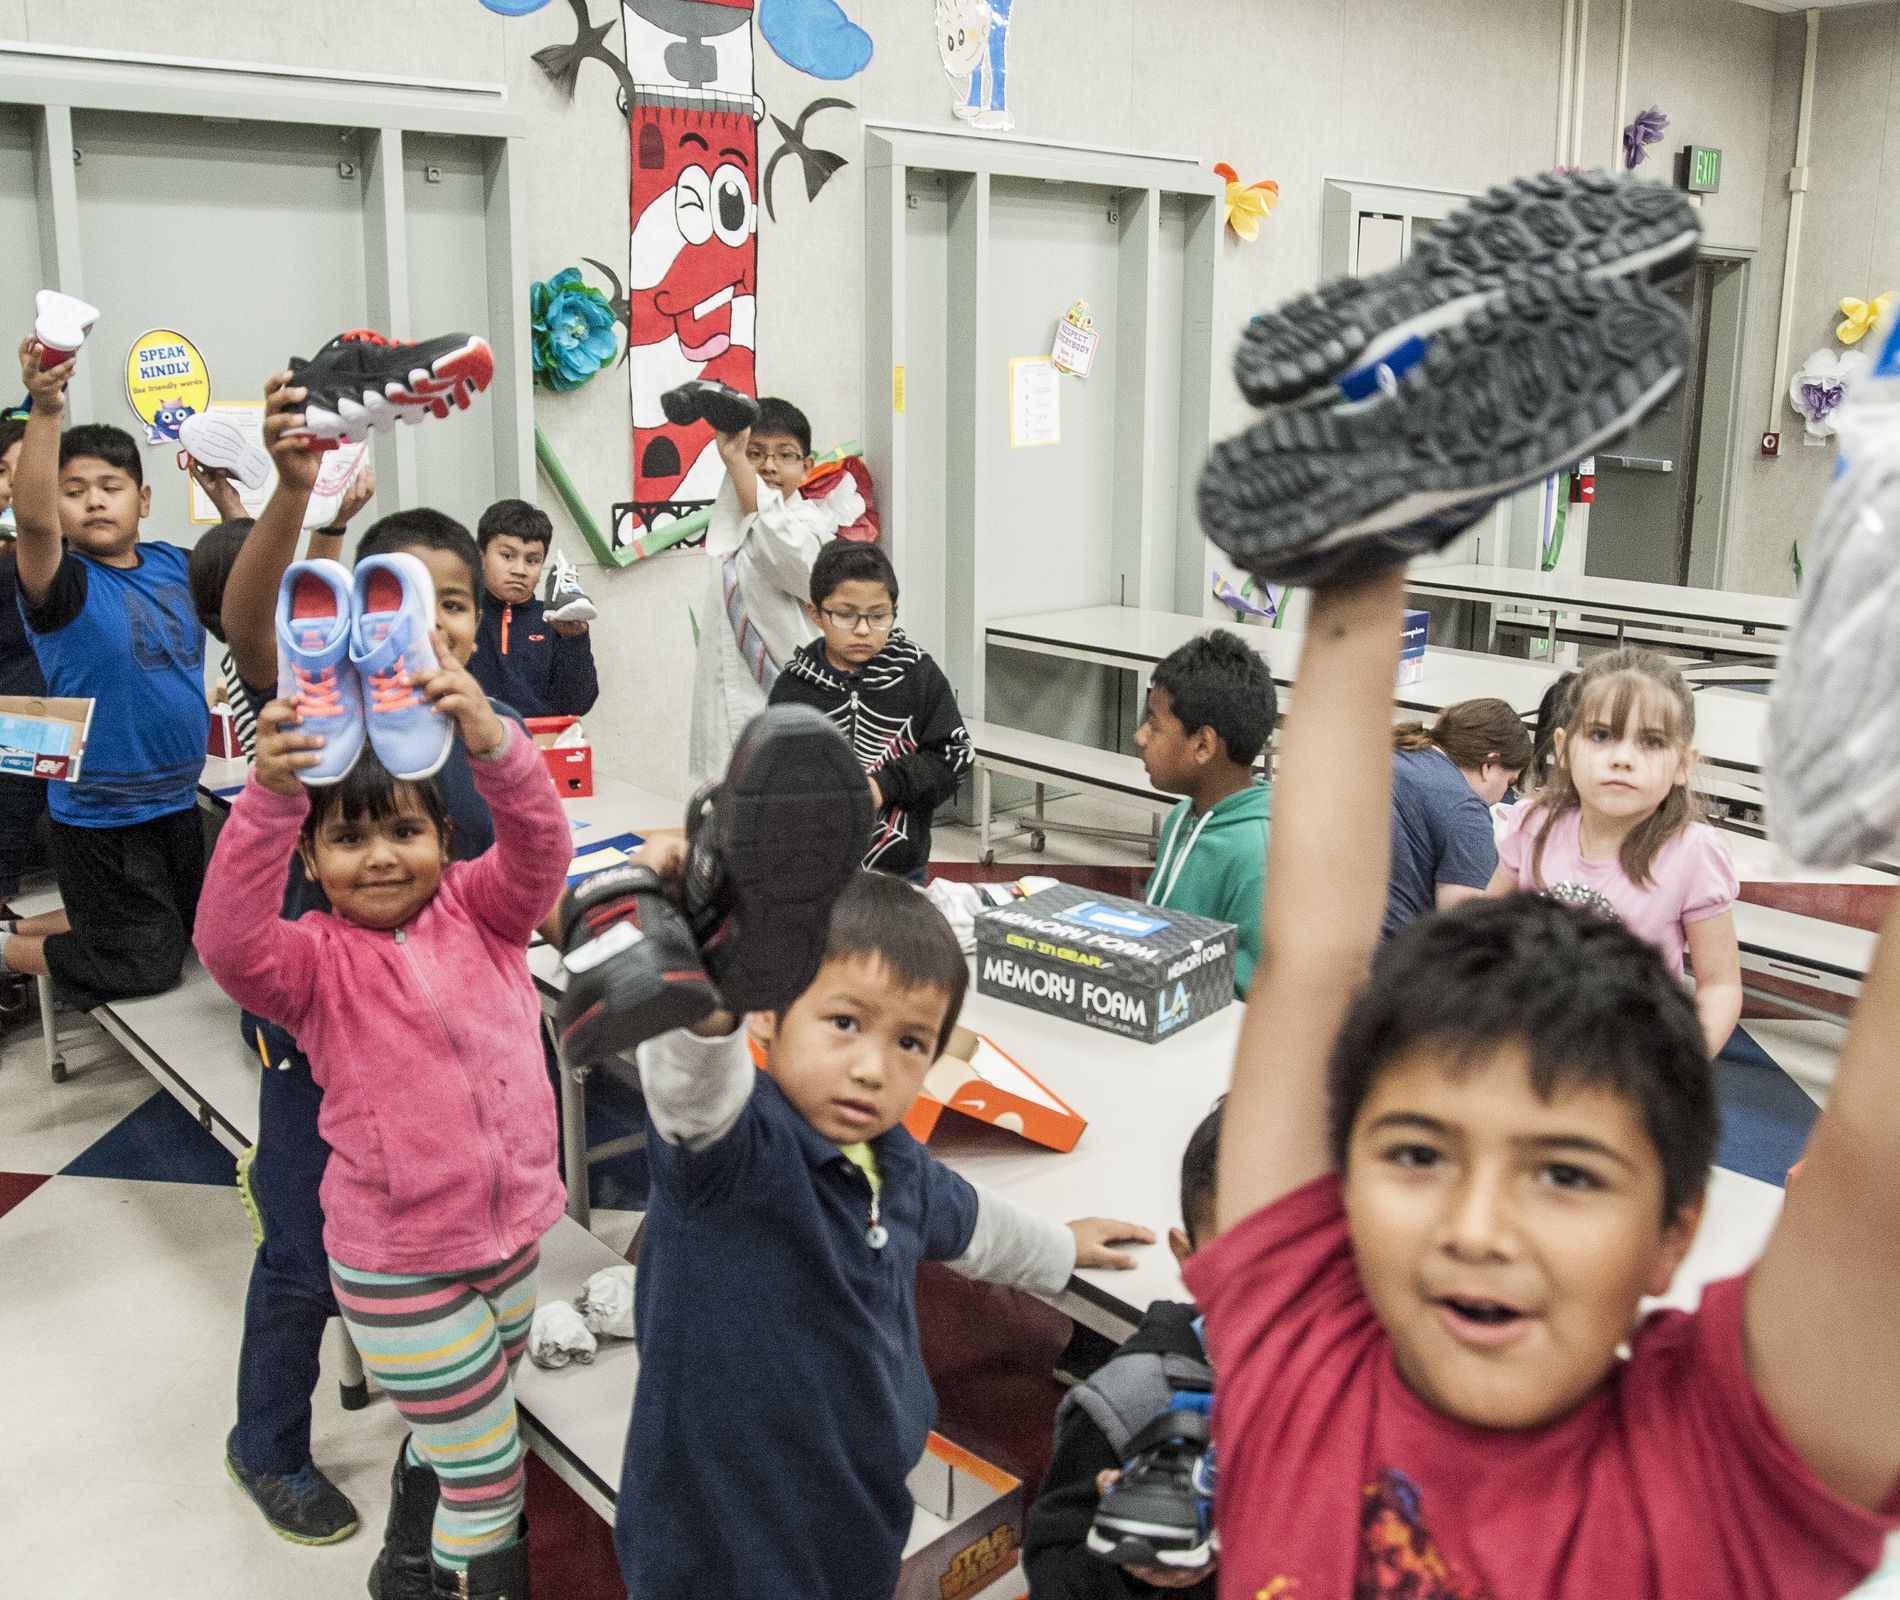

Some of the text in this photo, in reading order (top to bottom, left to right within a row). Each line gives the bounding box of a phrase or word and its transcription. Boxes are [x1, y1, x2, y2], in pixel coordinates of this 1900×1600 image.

[1696, 150, 1717, 185] EXIT
[139, 345, 186, 362] SPEAK
[140, 361, 190, 379] KINDLY
[985, 909, 1091, 940] MEMORY
[1085, 934, 1160, 960] FOAM
[1166, 940, 1226, 981] MEMORY FOAM
[983, 956, 1148, 1027] MEMORY FOAM
[1158, 981, 1190, 1021] LA
